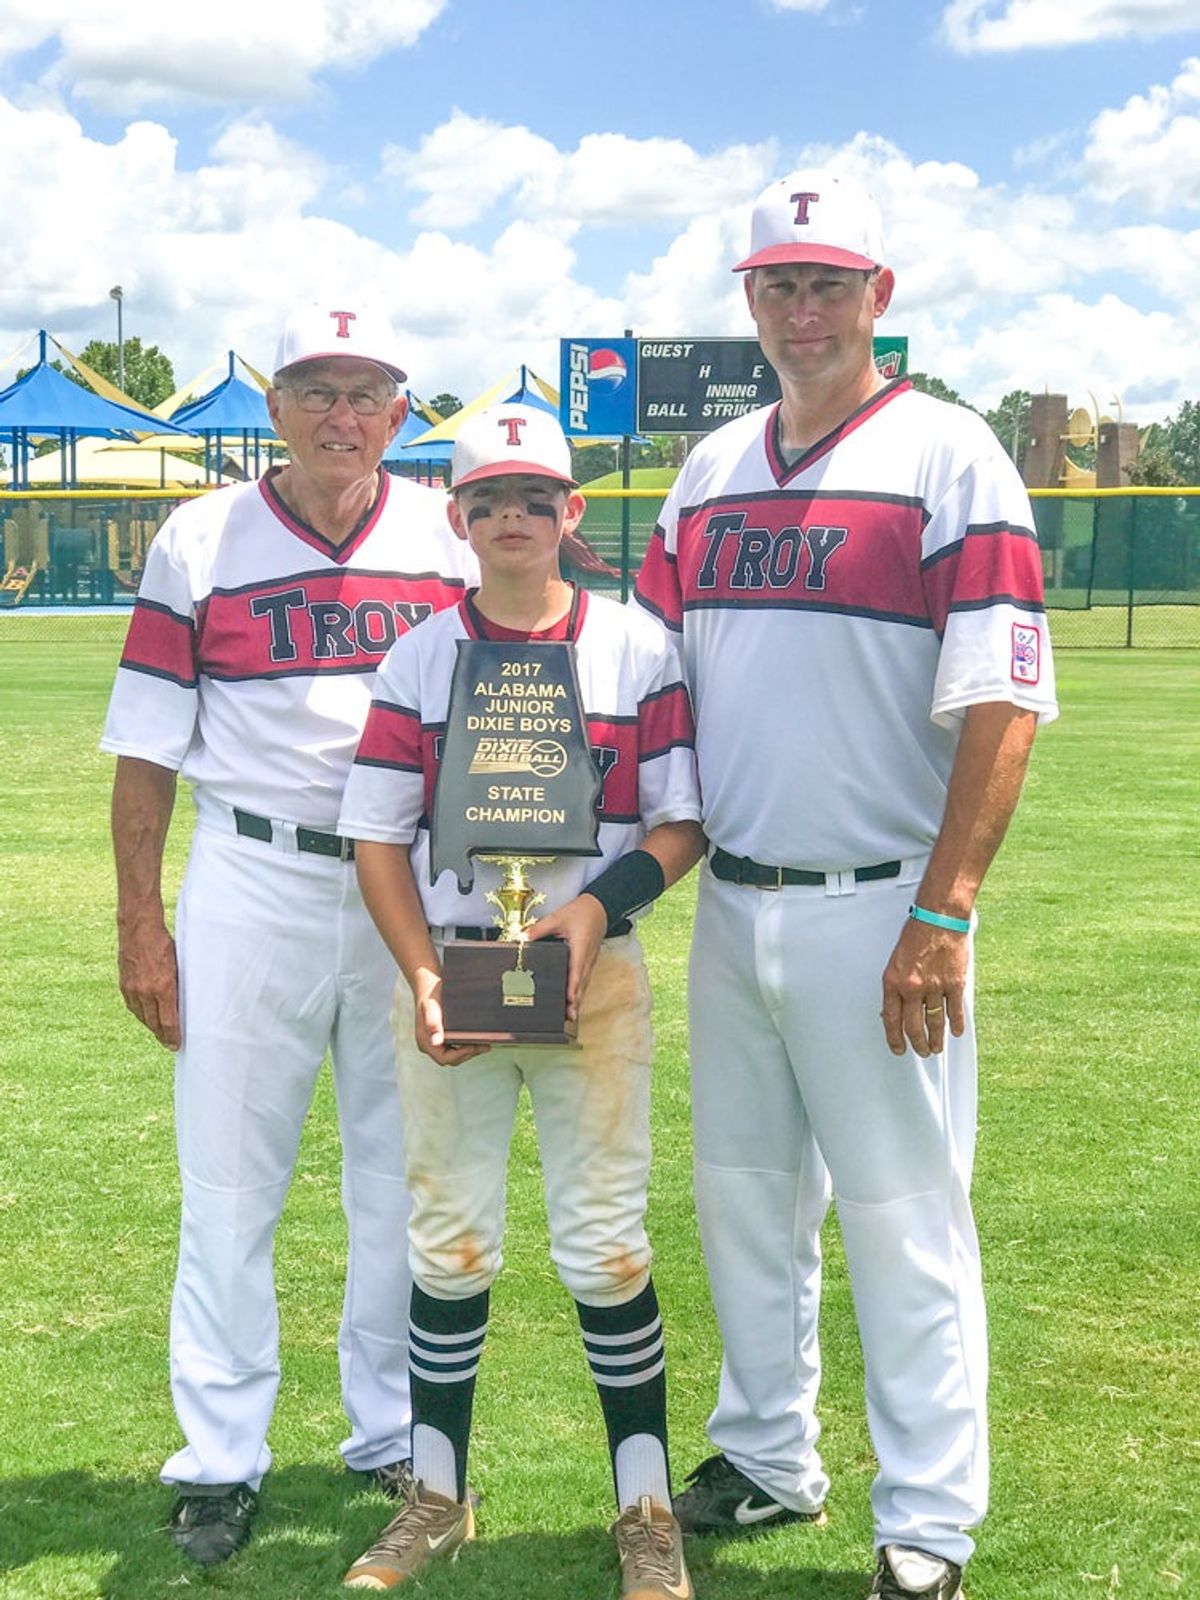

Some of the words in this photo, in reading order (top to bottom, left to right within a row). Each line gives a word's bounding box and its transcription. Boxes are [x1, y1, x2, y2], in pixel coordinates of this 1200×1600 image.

[790, 192, 820, 225] T
[329, 310, 356, 338] T
[641, 344, 694, 358] GUEST
[698, 365, 712, 379] H
[752, 365, 765, 378] E
[570, 342, 589, 432] PEPSI
[705, 384, 758, 398] INNING
[646, 403, 688, 417] BALL
[498, 417, 527, 446] T
[697, 511, 848, 590] TROY
[501, 662, 542, 677] 2017
[474, 682, 567, 699] ALABAMA
[485, 699, 555, 715] JUNIOR
[467, 716, 515, 732] DIXIE
[520, 717, 572, 734] BOYS
[477, 742, 533, 753] DIXIE
[474, 753, 562, 763] BASEBALL
[488, 785, 545, 802] STATE
[466, 806, 565, 824] CHAMPION
